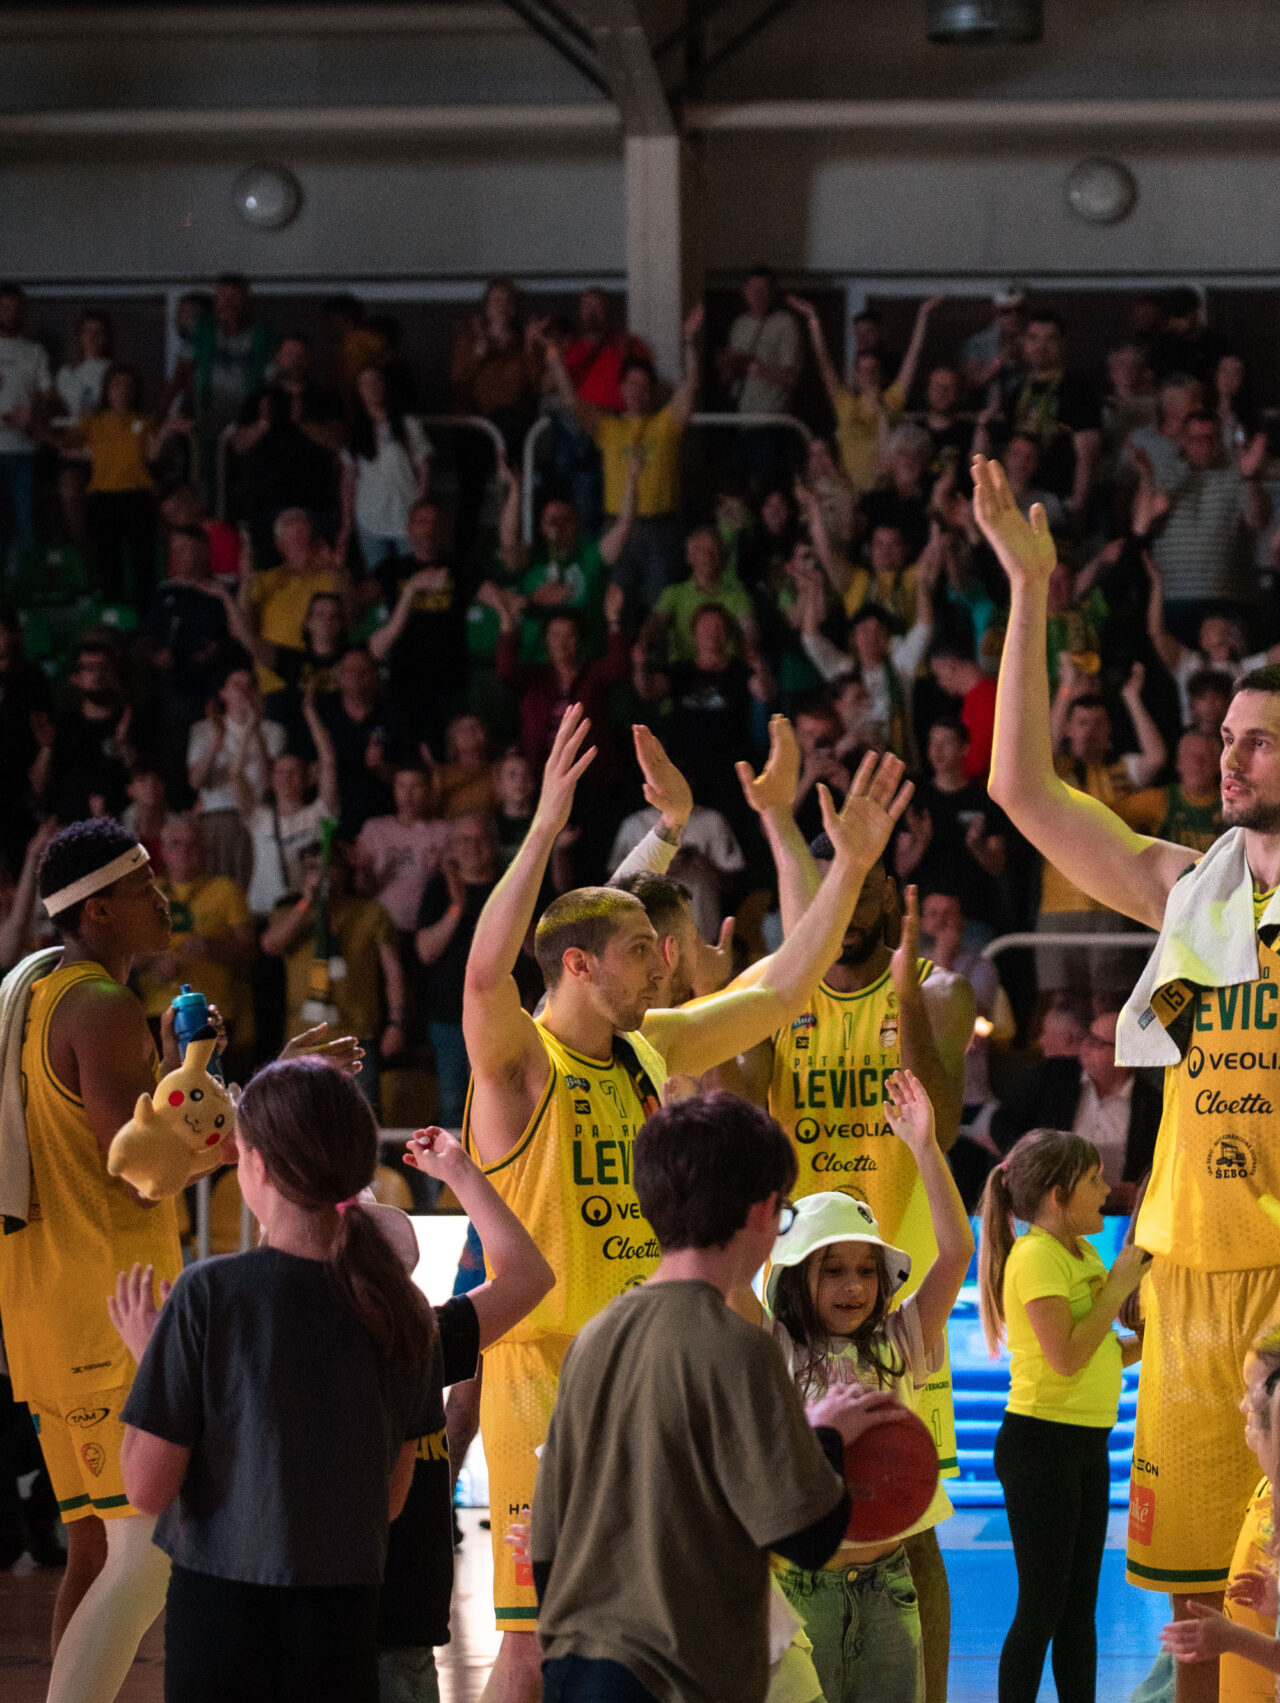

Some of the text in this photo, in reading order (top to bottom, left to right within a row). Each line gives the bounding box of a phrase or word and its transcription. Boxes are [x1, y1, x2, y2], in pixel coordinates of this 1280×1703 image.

[1161, 985, 1185, 1012] 15
[843, 1012, 853, 1050] 1
[794, 1053, 900, 1068] PATRIOTI
[599, 1079, 627, 1118] 7
[792, 1067, 901, 1109] LEVICE
[1195, 1089, 1274, 1115] Cloetta
[823, 1123, 896, 1138] VEOLIA
[572, 1139, 635, 1186] LEV
[810, 1151, 878, 1172] Cloetta
[1215, 1167, 1248, 1179] ŠEBO
[616, 1203, 641, 1220] VE
[509, 1504, 531, 1516] HA
